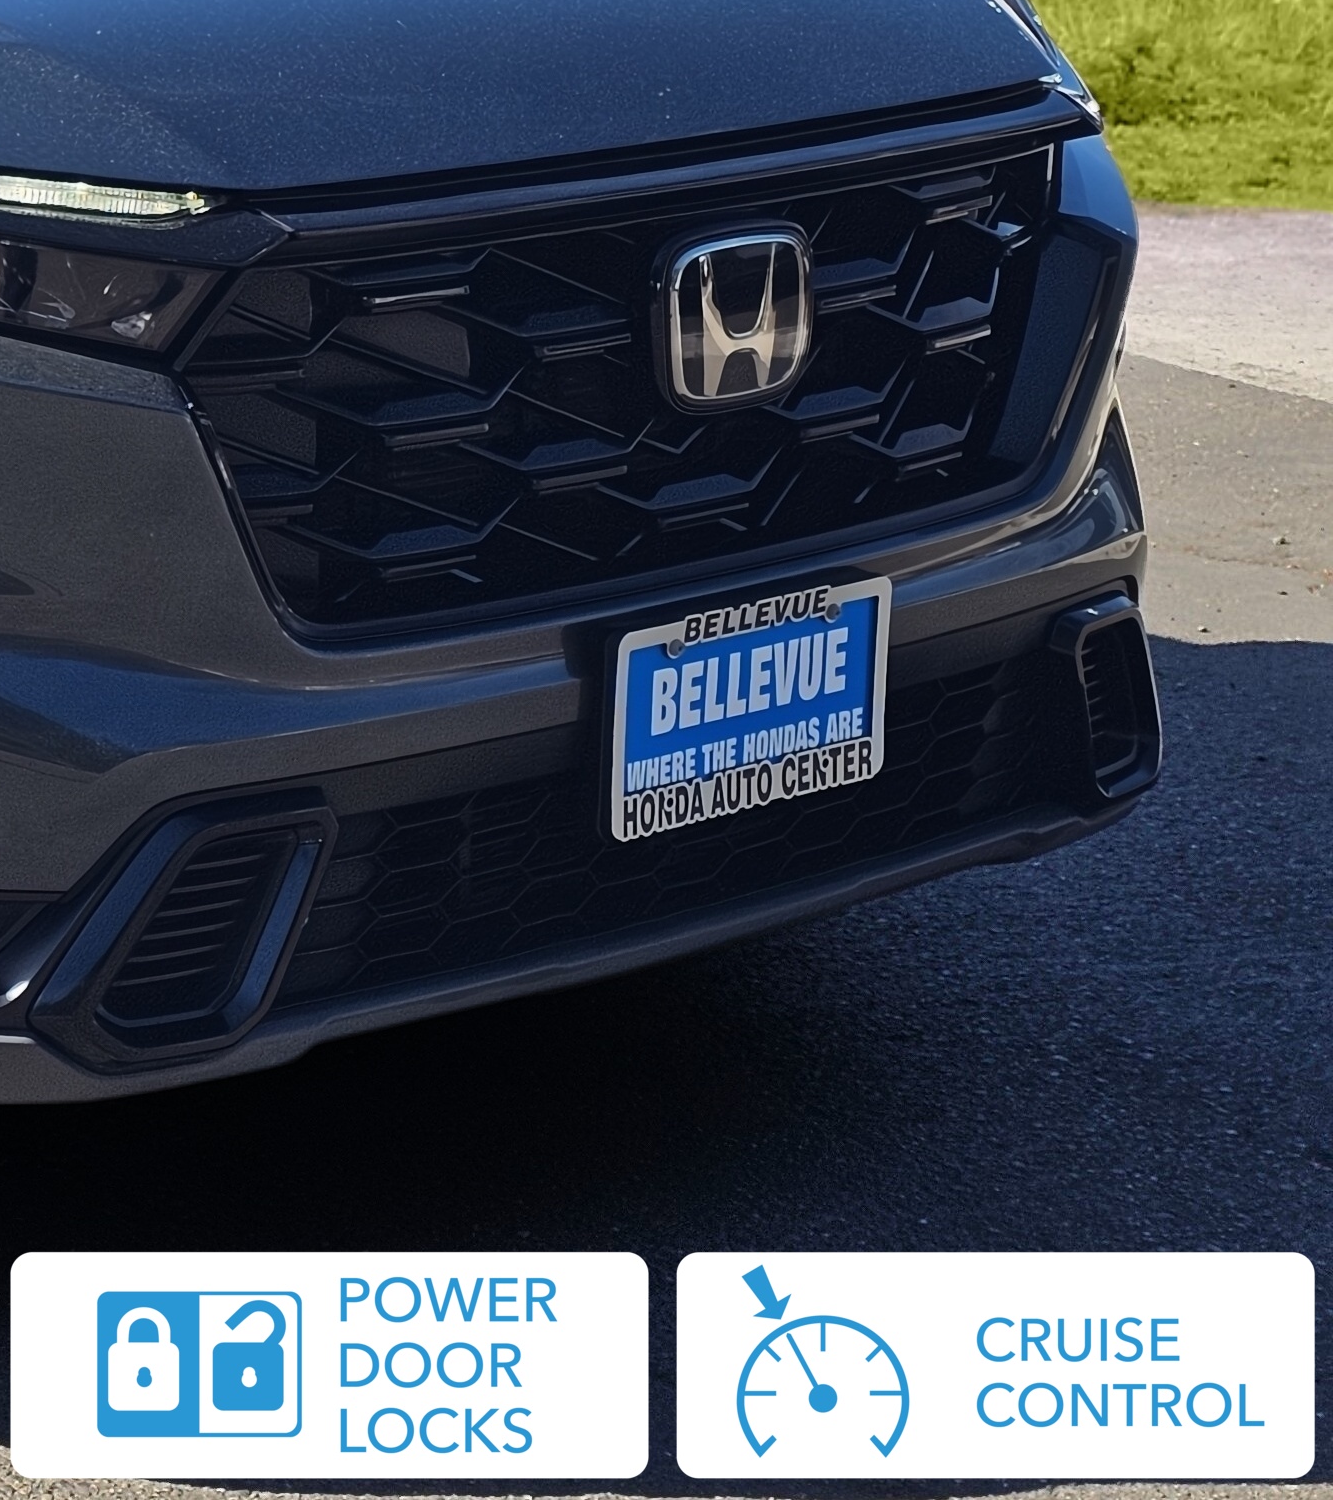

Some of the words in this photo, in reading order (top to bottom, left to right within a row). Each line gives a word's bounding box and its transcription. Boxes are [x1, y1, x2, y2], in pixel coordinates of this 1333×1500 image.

[684, 588, 829, 644] BELLEVUE
[650, 627, 849, 737] BELLEVUE
[622, 781, 705, 839] HONDA
[710, 763, 773, 820] AUTO
[781, 740, 873, 797] CENTER
[627, 750, 697, 793] WHERE
[702, 738, 737, 774] THE
[743, 717, 820, 765] HONDAS
[824, 706, 864, 746] ARE
